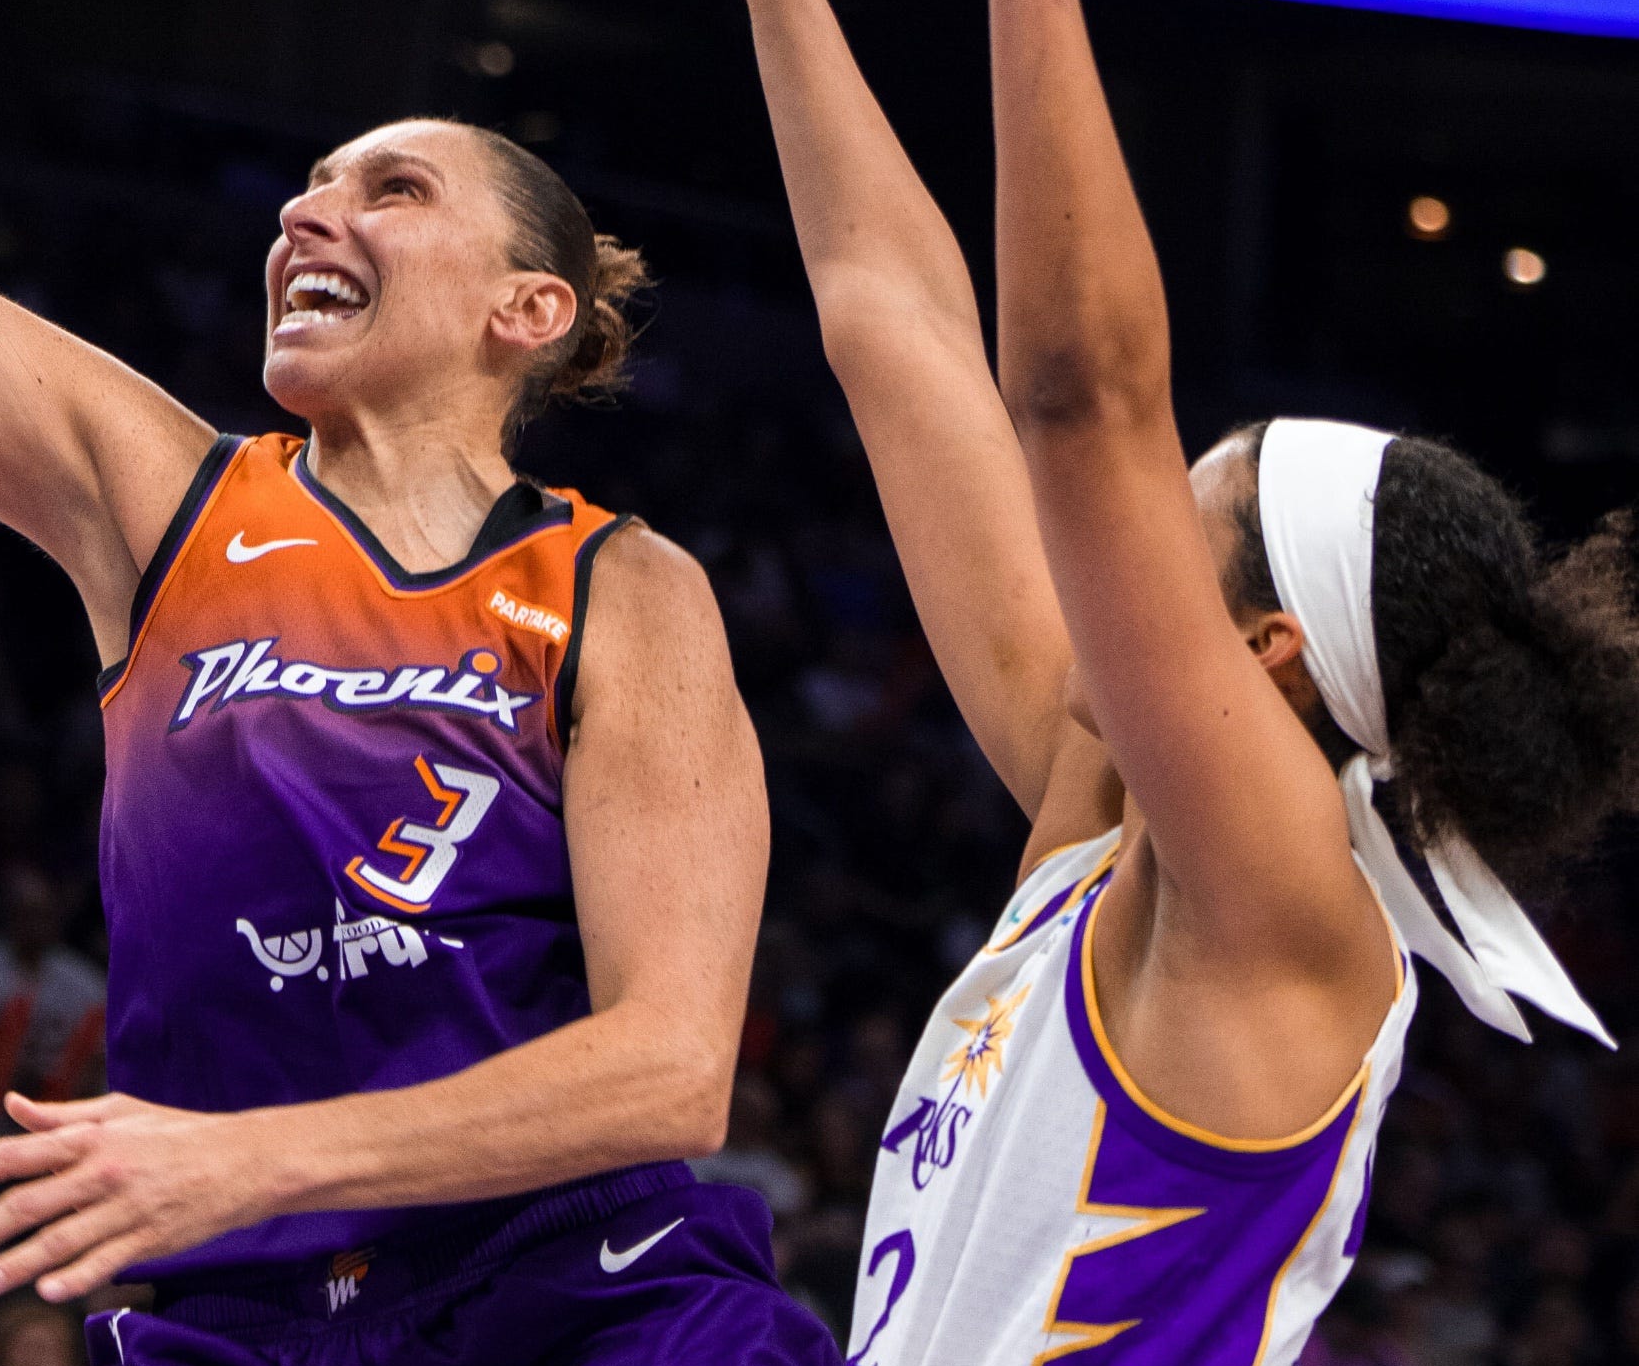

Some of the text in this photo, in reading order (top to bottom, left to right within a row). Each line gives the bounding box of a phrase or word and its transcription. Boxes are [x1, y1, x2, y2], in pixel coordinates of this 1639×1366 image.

[489, 589, 568, 641] PARTAKE
[171, 638, 540, 732] Phoenix
[344, 752, 501, 914] 3
